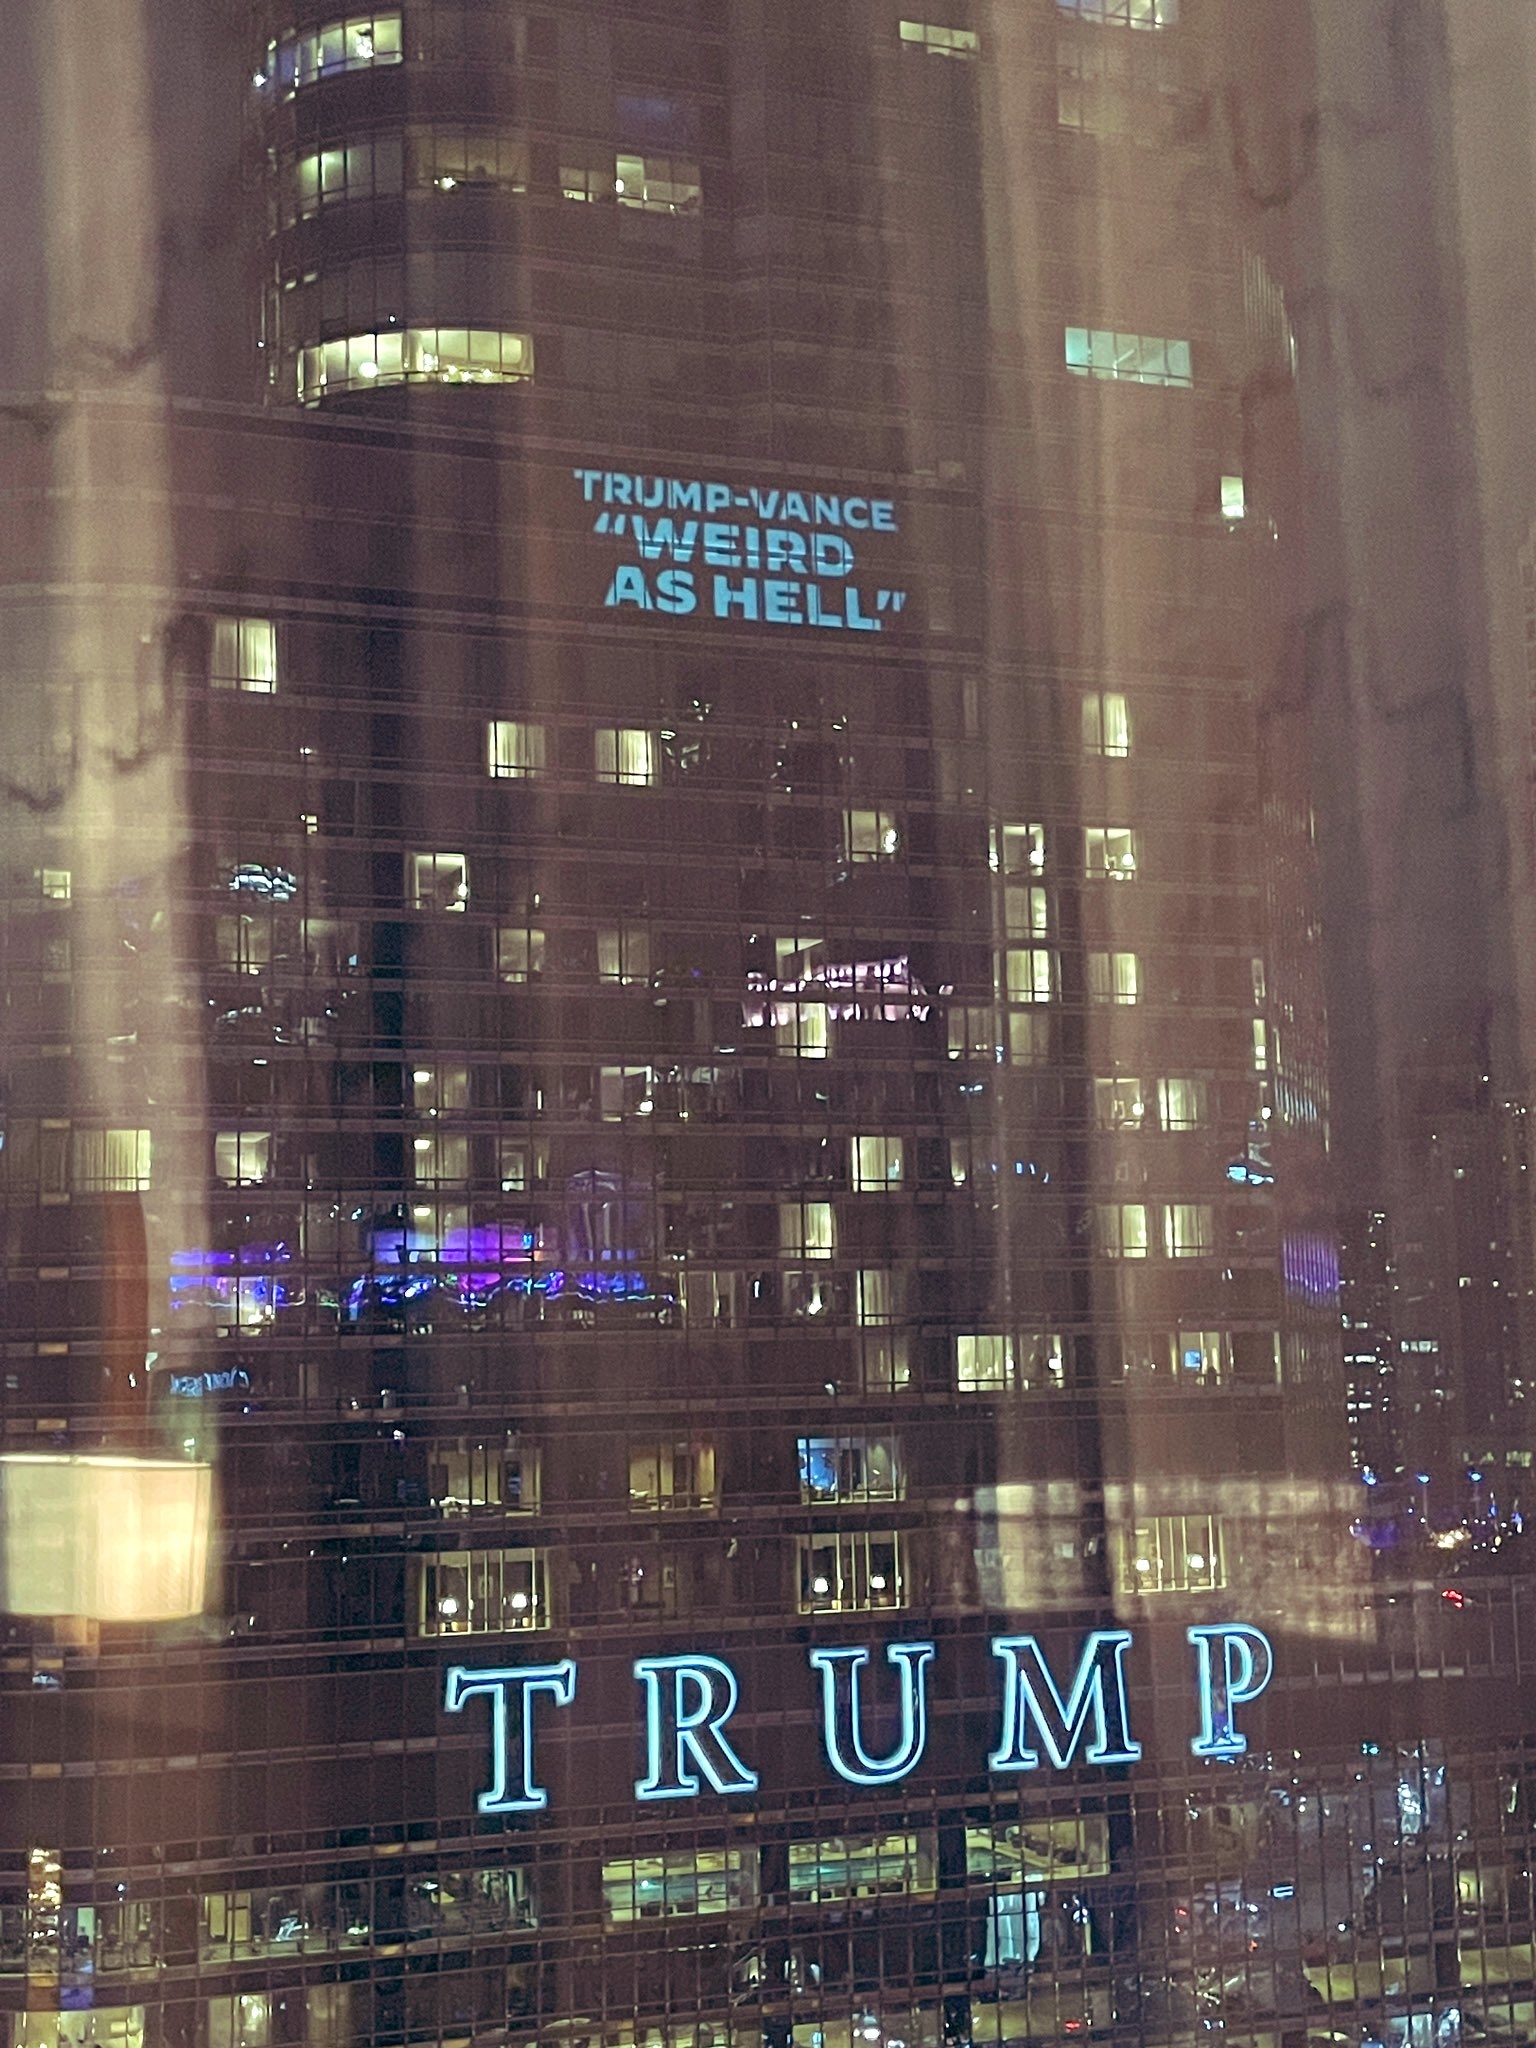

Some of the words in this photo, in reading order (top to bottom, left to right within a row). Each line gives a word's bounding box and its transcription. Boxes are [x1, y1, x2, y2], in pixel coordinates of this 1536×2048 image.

[573, 469, 898, 532] TRUMP-VANCE
[603, 565, 697, 615] AS
[444, 1623, 1274, 1813] TRUMP
